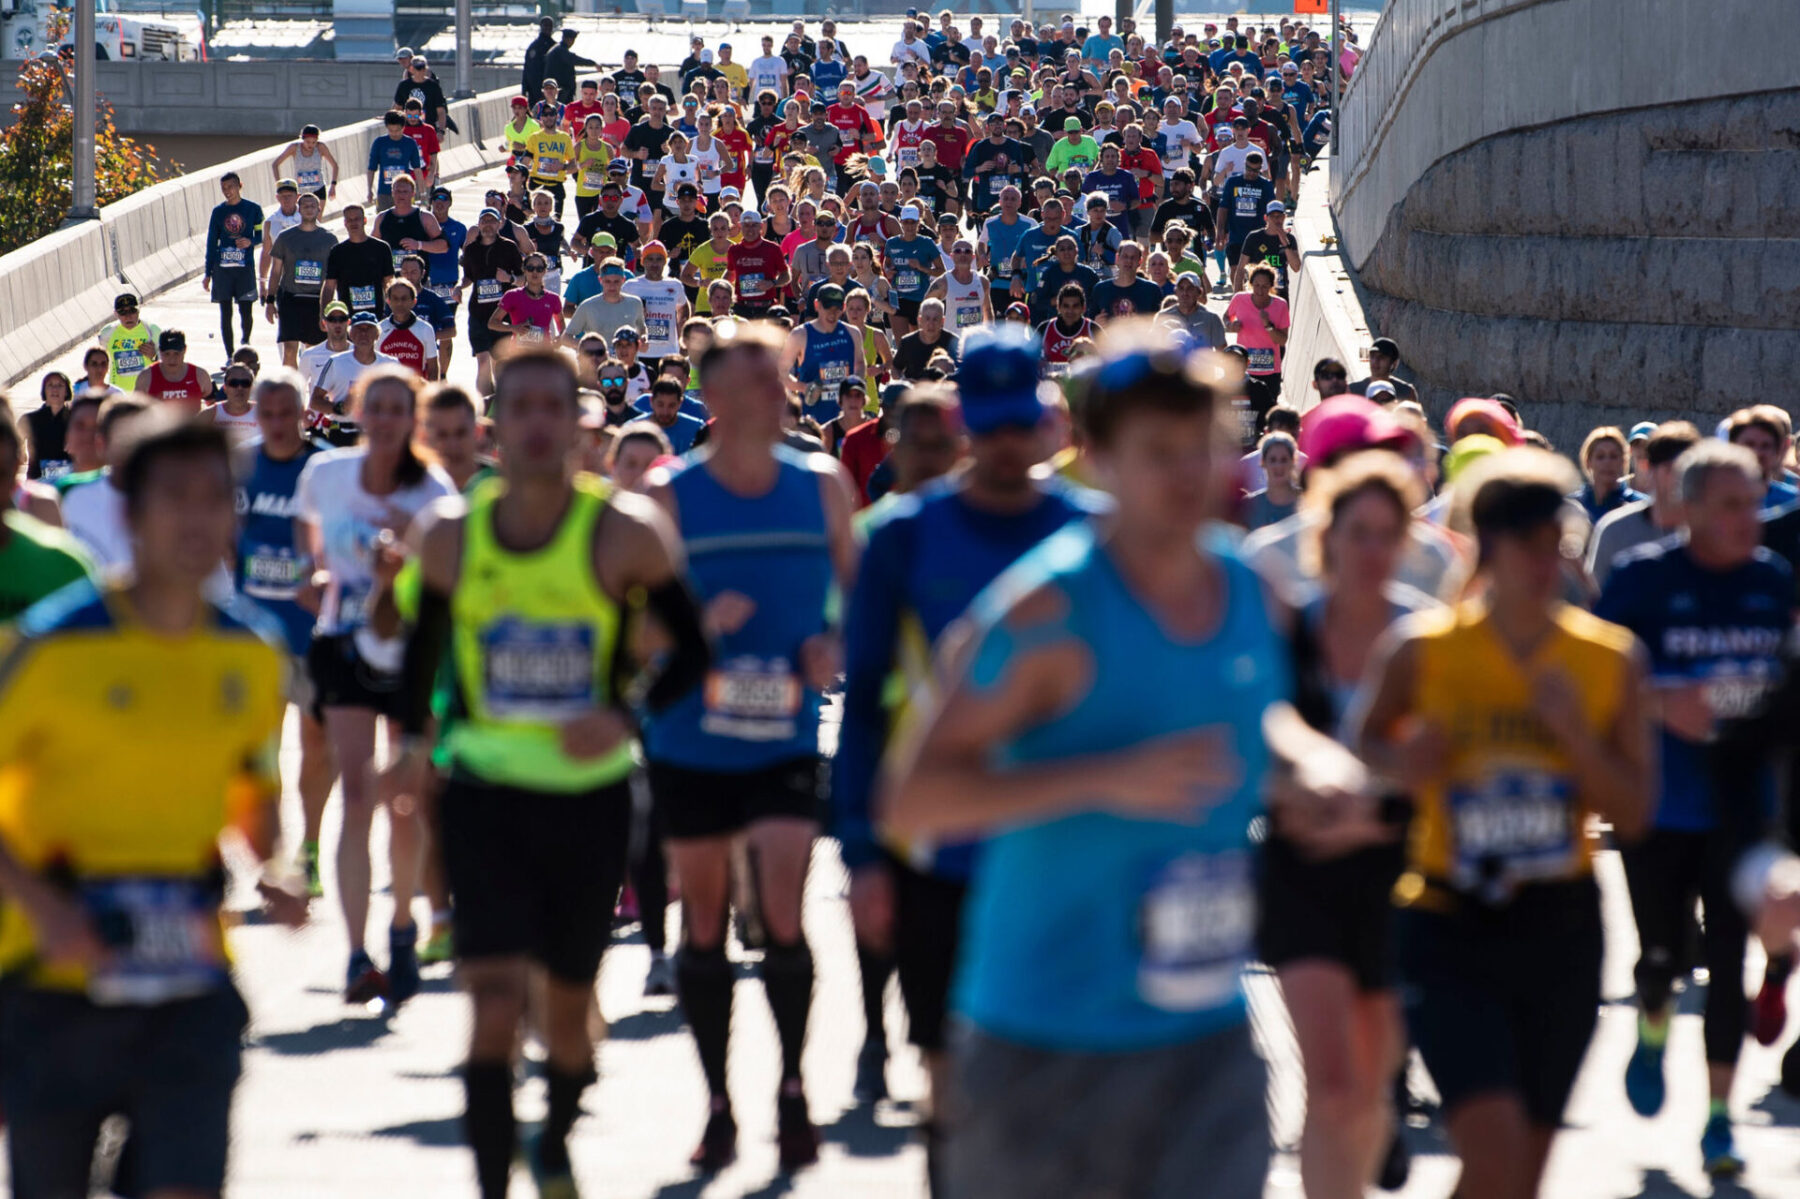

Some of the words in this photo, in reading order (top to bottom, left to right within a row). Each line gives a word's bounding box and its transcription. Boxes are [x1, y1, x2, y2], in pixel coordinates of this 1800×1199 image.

[538, 142, 566, 154] EVAN
[163, 389, 188, 400] PPTC
[1663, 626, 1782, 657] FRANC
